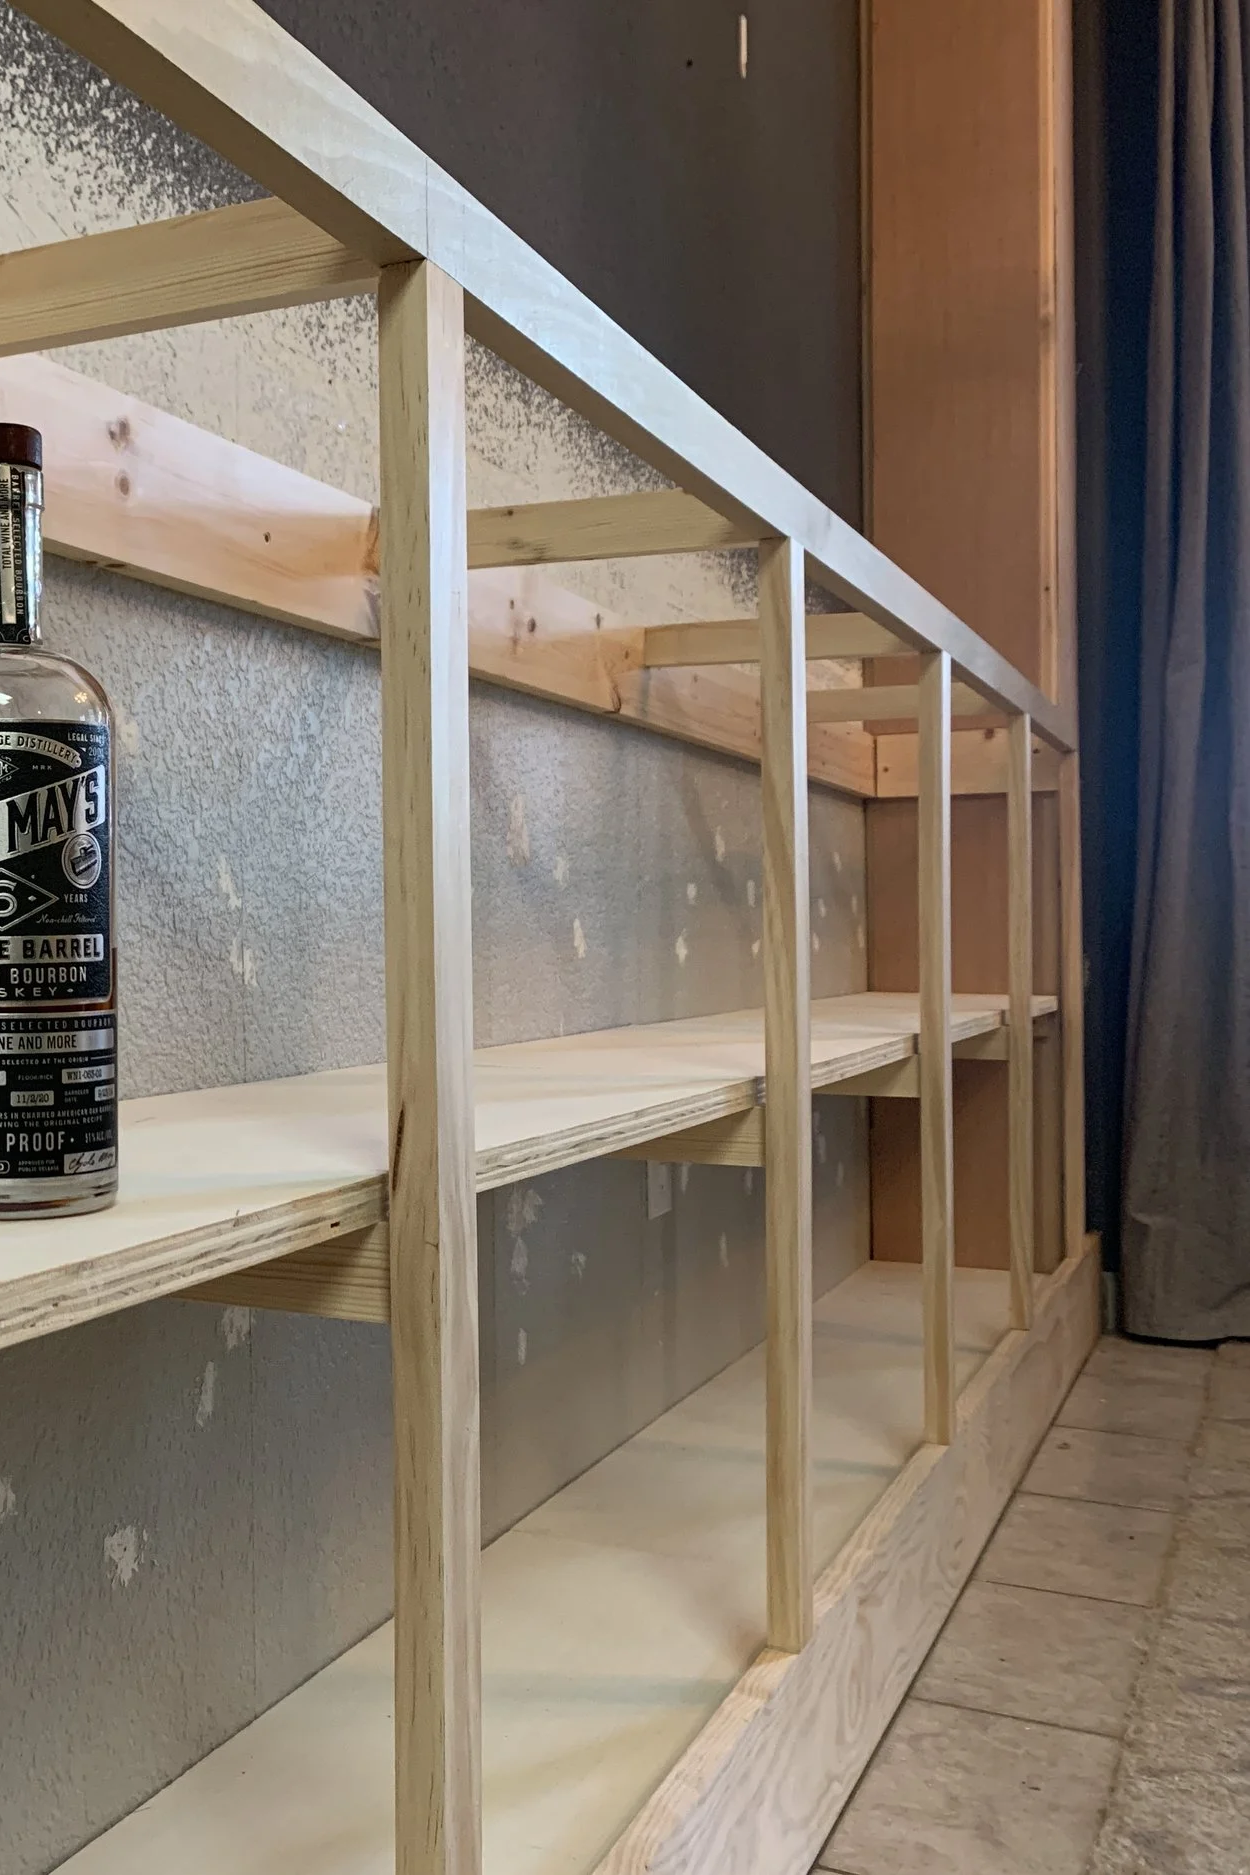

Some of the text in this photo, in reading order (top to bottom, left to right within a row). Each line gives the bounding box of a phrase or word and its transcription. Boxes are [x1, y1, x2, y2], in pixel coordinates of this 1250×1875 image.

[0, 478, 12, 569] TOTAL WINE AND MORE
[12, 518, 23, 565] SELECTED
[15, 569, 24, 615] BOURBON
[67, 732, 88, 742] LEGAL
[17, 736, 77, 763] DISTILLERY
[6, 770, 101, 854] MAY'S
[63, 893, 89, 903] YEARS
[21, 937, 102, 960] BARREL
[10, 965, 88, 985] BOURBON
[1, 1020, 68, 1031] SELECTED
[18, 1035, 43, 1050] AND
[46, 1034, 78, 1049] MORE
[1, 1058, 39, 1066] SELECTED
[10, 1112, 19, 1120] IN
[43, 1118, 80, 1127] ORIGINAL
[6, 1130, 66, 1153] PROOF
